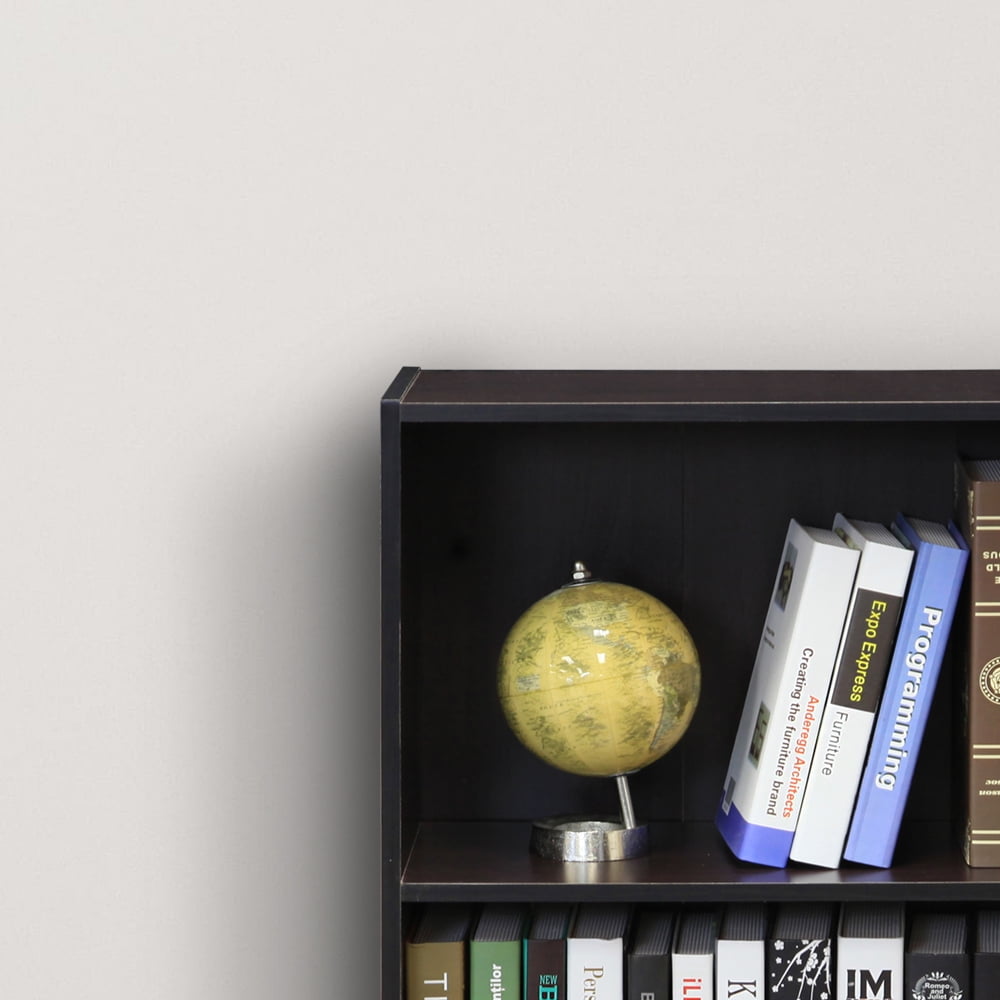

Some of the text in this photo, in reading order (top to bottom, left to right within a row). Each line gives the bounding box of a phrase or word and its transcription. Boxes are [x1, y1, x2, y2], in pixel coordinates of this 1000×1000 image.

[850, 600, 888, 703] Expo Express
[875, 606, 943, 791] Programming
[766, 647, 814, 817] Creating the furniture brand
[782, 695, 820, 819] Anderegg Architects
[821, 711, 849, 777] Furniture
[539, 975, 558, 985] NEW
